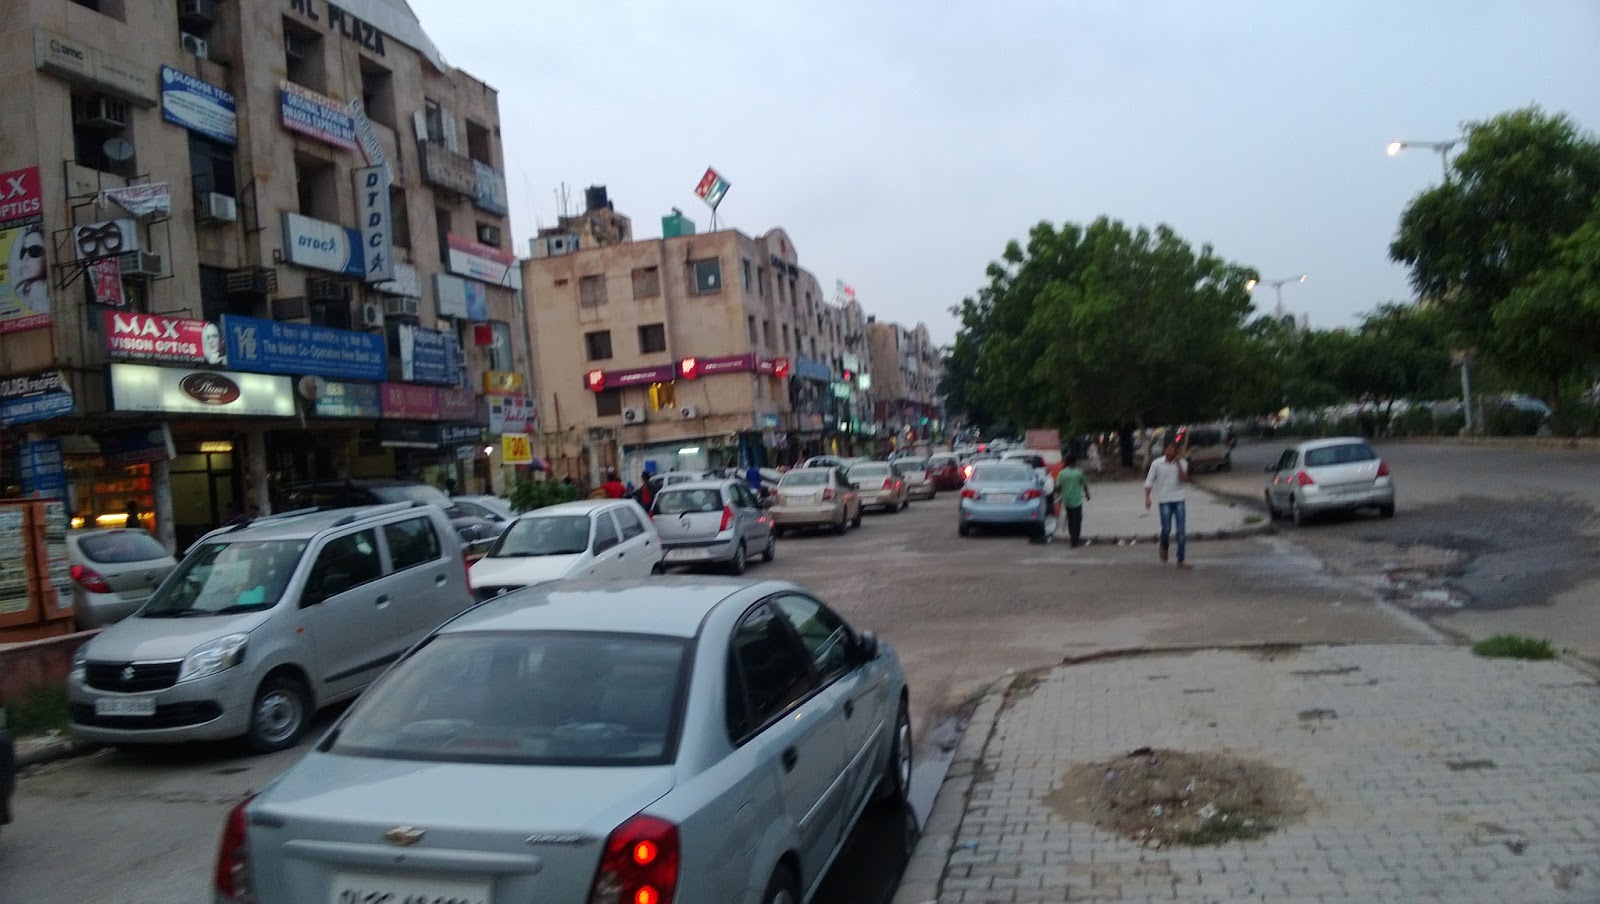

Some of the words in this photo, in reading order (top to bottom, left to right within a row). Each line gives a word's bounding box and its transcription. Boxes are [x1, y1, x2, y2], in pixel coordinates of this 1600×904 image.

[327, 2, 386, 58] PLAZA
[0, 197, 40, 218] PTICS
[366, 172, 383, 248] DTDC
[298, 235, 328, 251] DTDC
[113, 312, 180, 340] MAX
[110, 336, 153, 352] VISION
[155, 339, 197, 355] OPTICS
